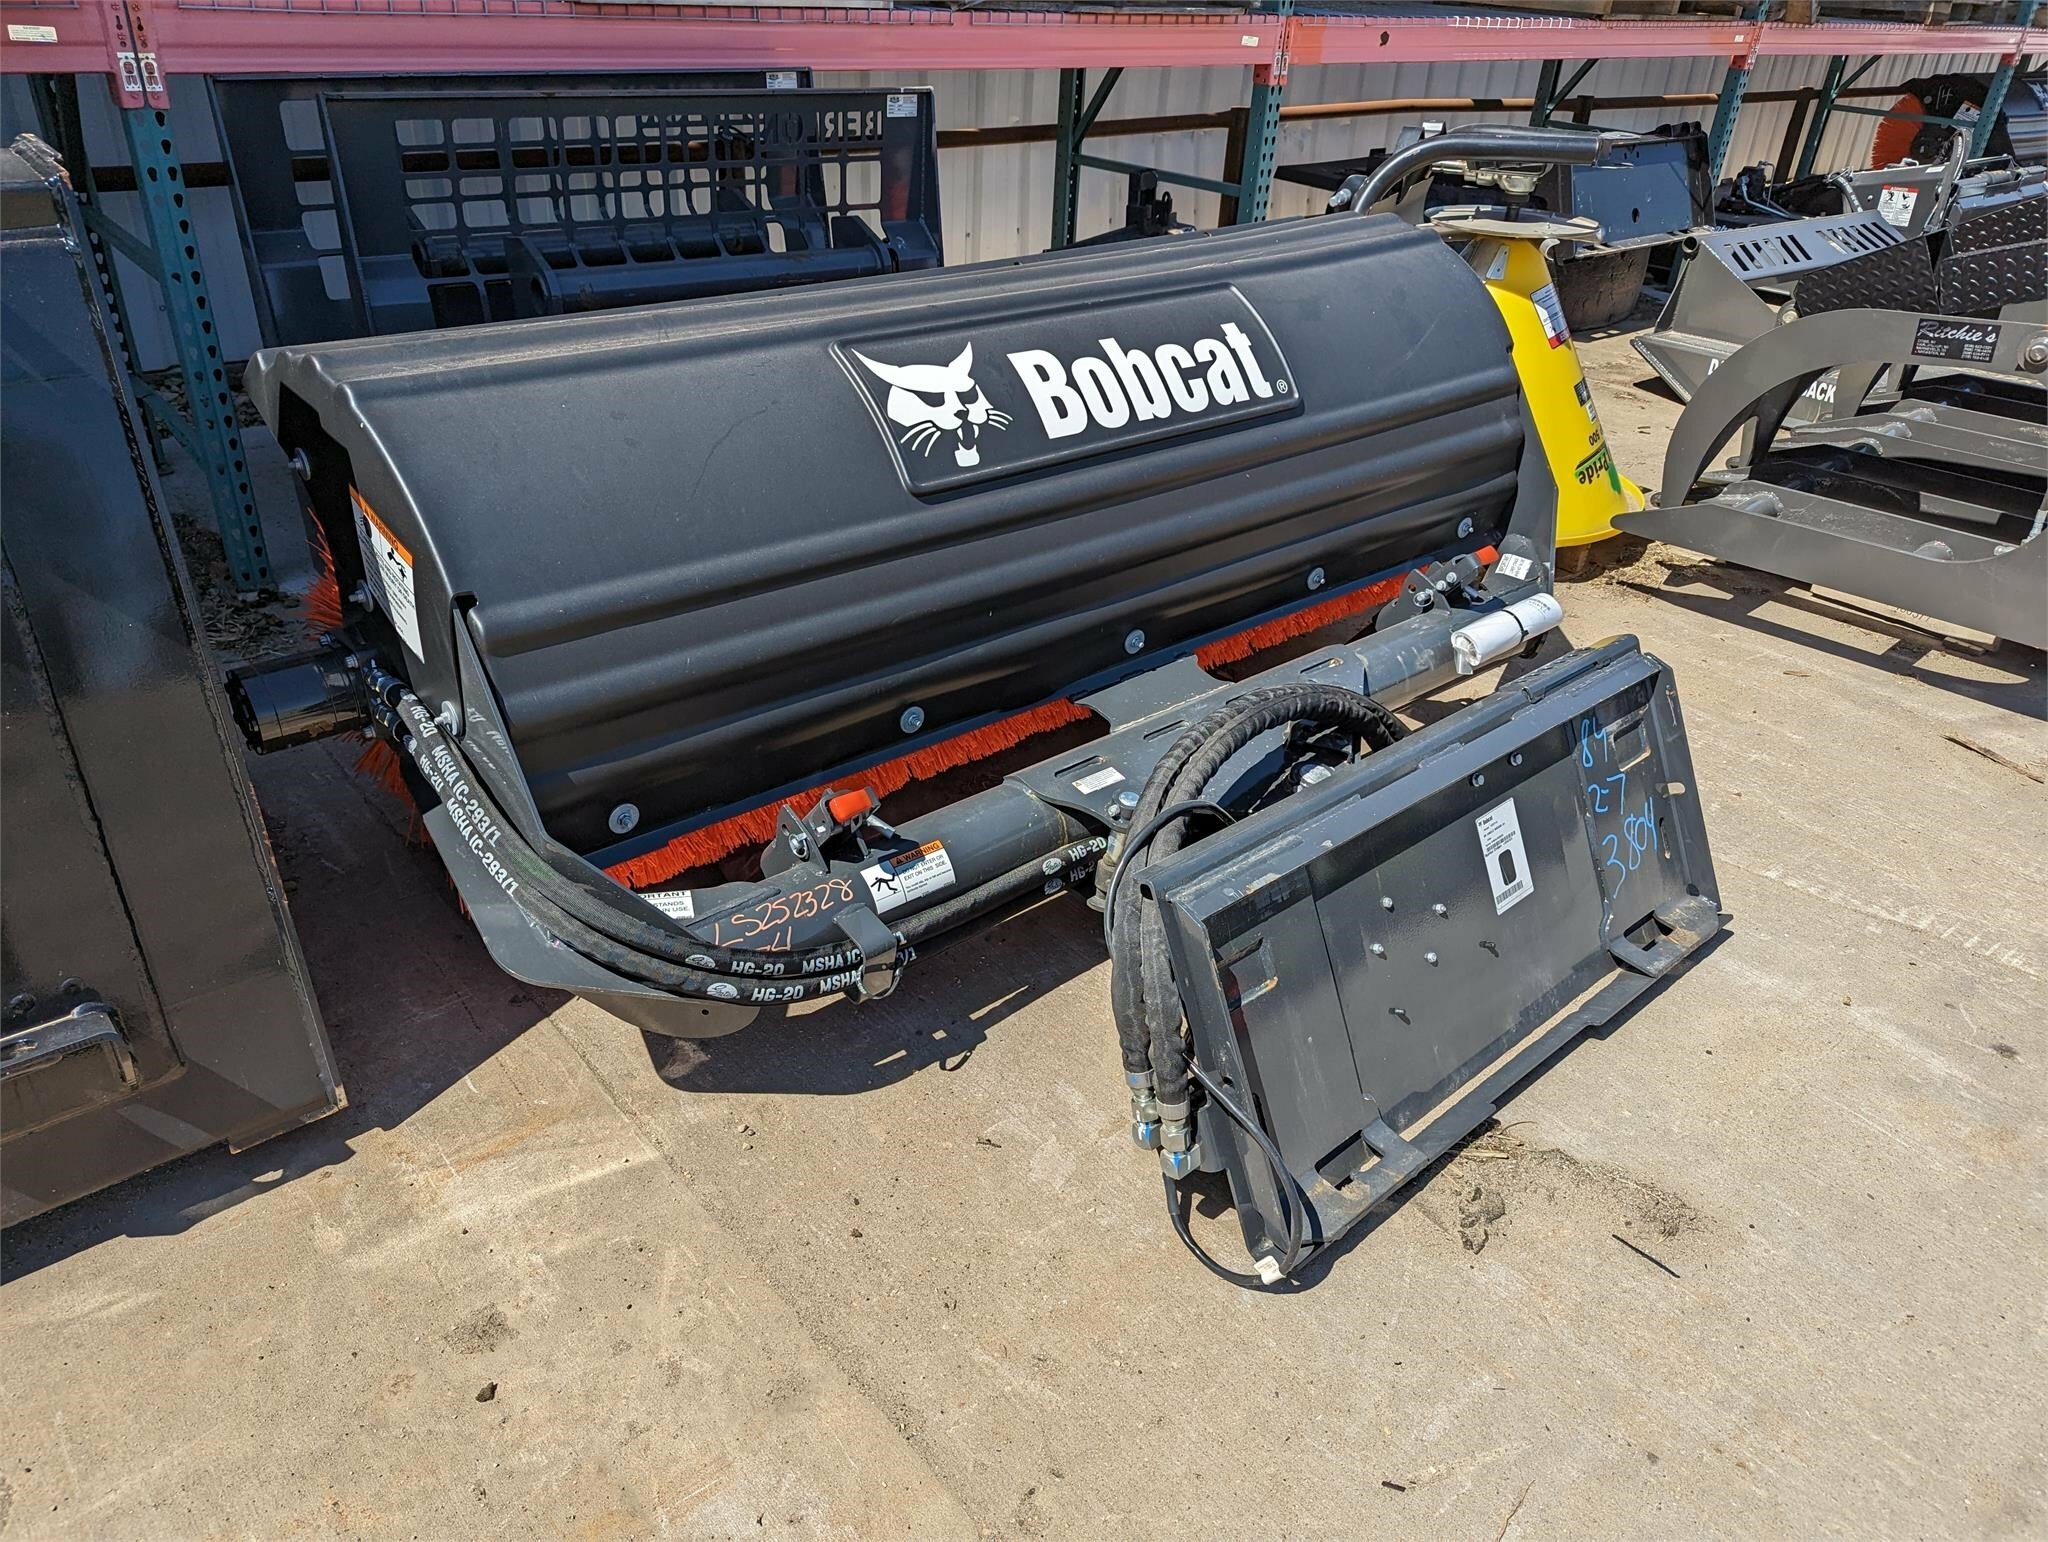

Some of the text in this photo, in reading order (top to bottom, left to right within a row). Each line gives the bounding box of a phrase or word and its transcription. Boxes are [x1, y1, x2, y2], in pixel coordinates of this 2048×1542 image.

[1917, 320, 1998, 343] Ritchie's
[1007, 322, 1273, 439] Bobcat
[1801, 380, 1837, 404] ACK
[410, 705, 438, 738] HG-20
[432, 745, 459, 787] MSHA
[1579, 716, 1609, 768] 84
[420, 754, 444, 793] HG-20
[446, 798, 474, 841] MSHA
[903, 842, 940, 861] WARNING
[1068, 837, 1107, 862] HG-20
[1601, 796, 1658, 899] 3804
[920, 857, 936, 867] ENTER
[1070, 861, 1095, 882] HG-2
[903, 873, 914, 881] EXIT
[730, 961, 785, 976] HG-20
[802, 956, 845, 975] MSHA
[751, 985, 804, 1002] HG-20
[820, 970, 862, 995] MSHA
